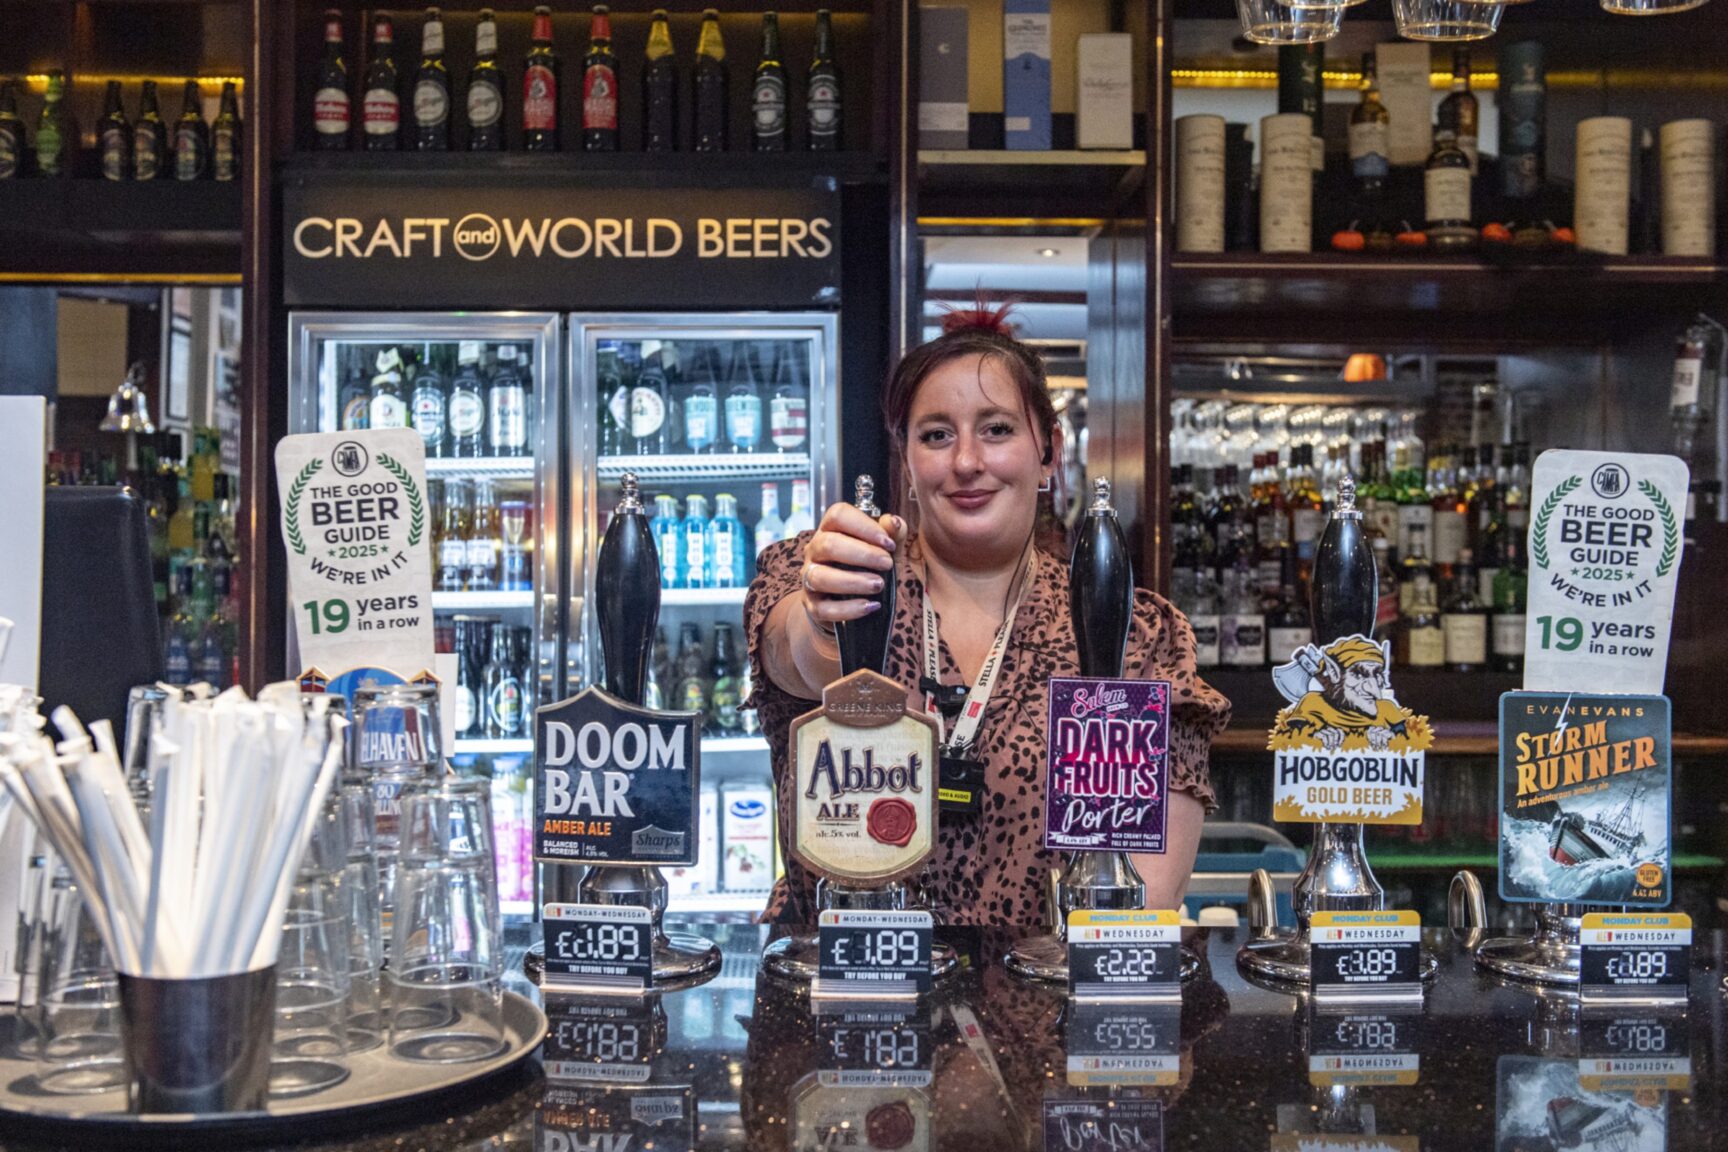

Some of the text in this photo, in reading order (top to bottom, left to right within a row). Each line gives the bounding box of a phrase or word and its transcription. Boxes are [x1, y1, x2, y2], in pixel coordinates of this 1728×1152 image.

[293, 216, 833, 259] CRAFT and WORLD BEERS
[310, 482, 398, 499] THE GOOD
[311, 497, 400, 526] BEER
[1563, 504, 1655, 521] THE GOOD
[324, 525, 390, 544] GUIDE
[1560, 519, 1653, 548] BEER
[339, 545, 378, 559] 2025
[1570, 547, 1639, 566] GUIDE
[310, 551, 408, 584] WE'RE IN IT
[1582, 567, 1623, 581] 2025
[1550, 573, 1652, 607] WE'RE IN IT
[303, 595, 419, 635] 19 years
[357, 617, 420, 631] in a row
[926, 609, 938, 680] STELLA PLEAS
[1536, 616, 1656, 652] 19 years
[1589, 641, 1654, 658] in a row
[978, 656, 997, 687] STELLA
[828, 703, 903, 712] GREENE KING
[1071, 682, 1127, 718] Salem
[545, 721, 687, 770] DOOM
[1057, 718, 1157, 764] DARK
[1515, 719, 1608, 763] STORM
[805, 738, 923, 800] Abbot
[1055, 758, 1159, 800] FRUITS
[1279, 755, 1420, 789] HOBGOBLIN
[1515, 736, 1658, 797] RUNNER
[544, 769, 636, 818] BAR
[1307, 786, 1393, 805] GOLD BEER
[1517, 799, 1527, 808] An
[816, 803, 861, 821] ALE
[1061, 798, 1152, 833] Porter
[543, 819, 612, 836] AMBER ALE
[543, 839, 579, 849] BALANCED
[636, 833, 681, 849] Sharps
[565, 910, 646, 918] MONDAY-WEDNESDAY
[1603, 917, 1669, 925] MONDAY CLUB
[1103, 929, 1164, 938] WEDNESDAY
[1345, 929, 1405, 938] WEDNESDAY
[1615, 932, 1676, 940] WEDNESDAY
[830, 930, 919, 966] £1.89
[1094, 949, 1157, 975] £2.22
